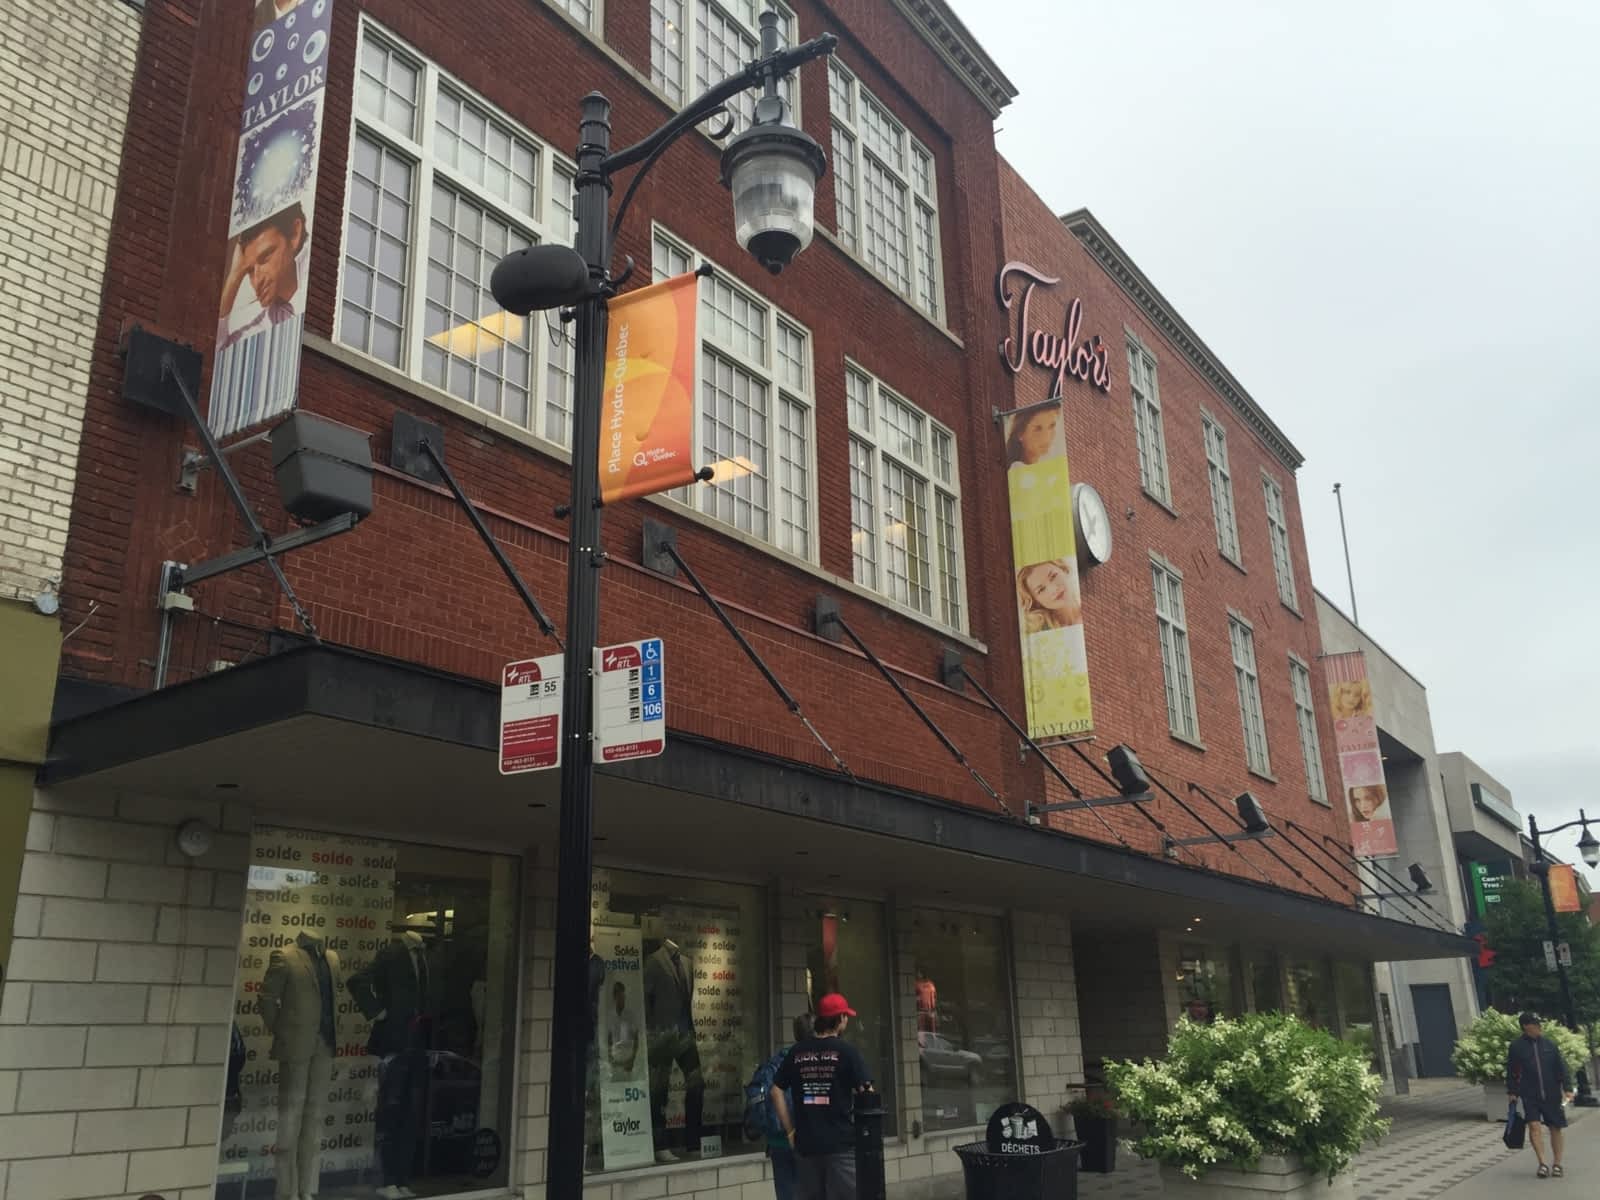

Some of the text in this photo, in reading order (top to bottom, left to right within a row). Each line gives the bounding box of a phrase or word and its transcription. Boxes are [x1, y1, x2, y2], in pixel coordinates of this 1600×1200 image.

[242, 65, 323, 128] TAYLOR
[609, 323, 630, 473] Place Hydro-Québec
[646, 666, 654, 677] 1
[544, 681, 557, 693] 55
[648, 684, 655, 696] 6
[643, 702, 662, 716] 106
[1031, 719, 1089, 737] TAYLOR
[255, 846, 302, 861] solde
[311, 851, 354, 866] solde
[285, 871, 329, 885] solde
[338, 875, 379, 888] solde
[255, 889, 393, 911] solde solde sold
[245, 909, 377, 930] lde solde solde
[324, 935, 350, 950] lde
[359, 938, 389, 951] sold
[712, 941, 737, 951] solde
[613, 1117, 640, 1136] taylor
[320, 1133, 363, 1150] solde
